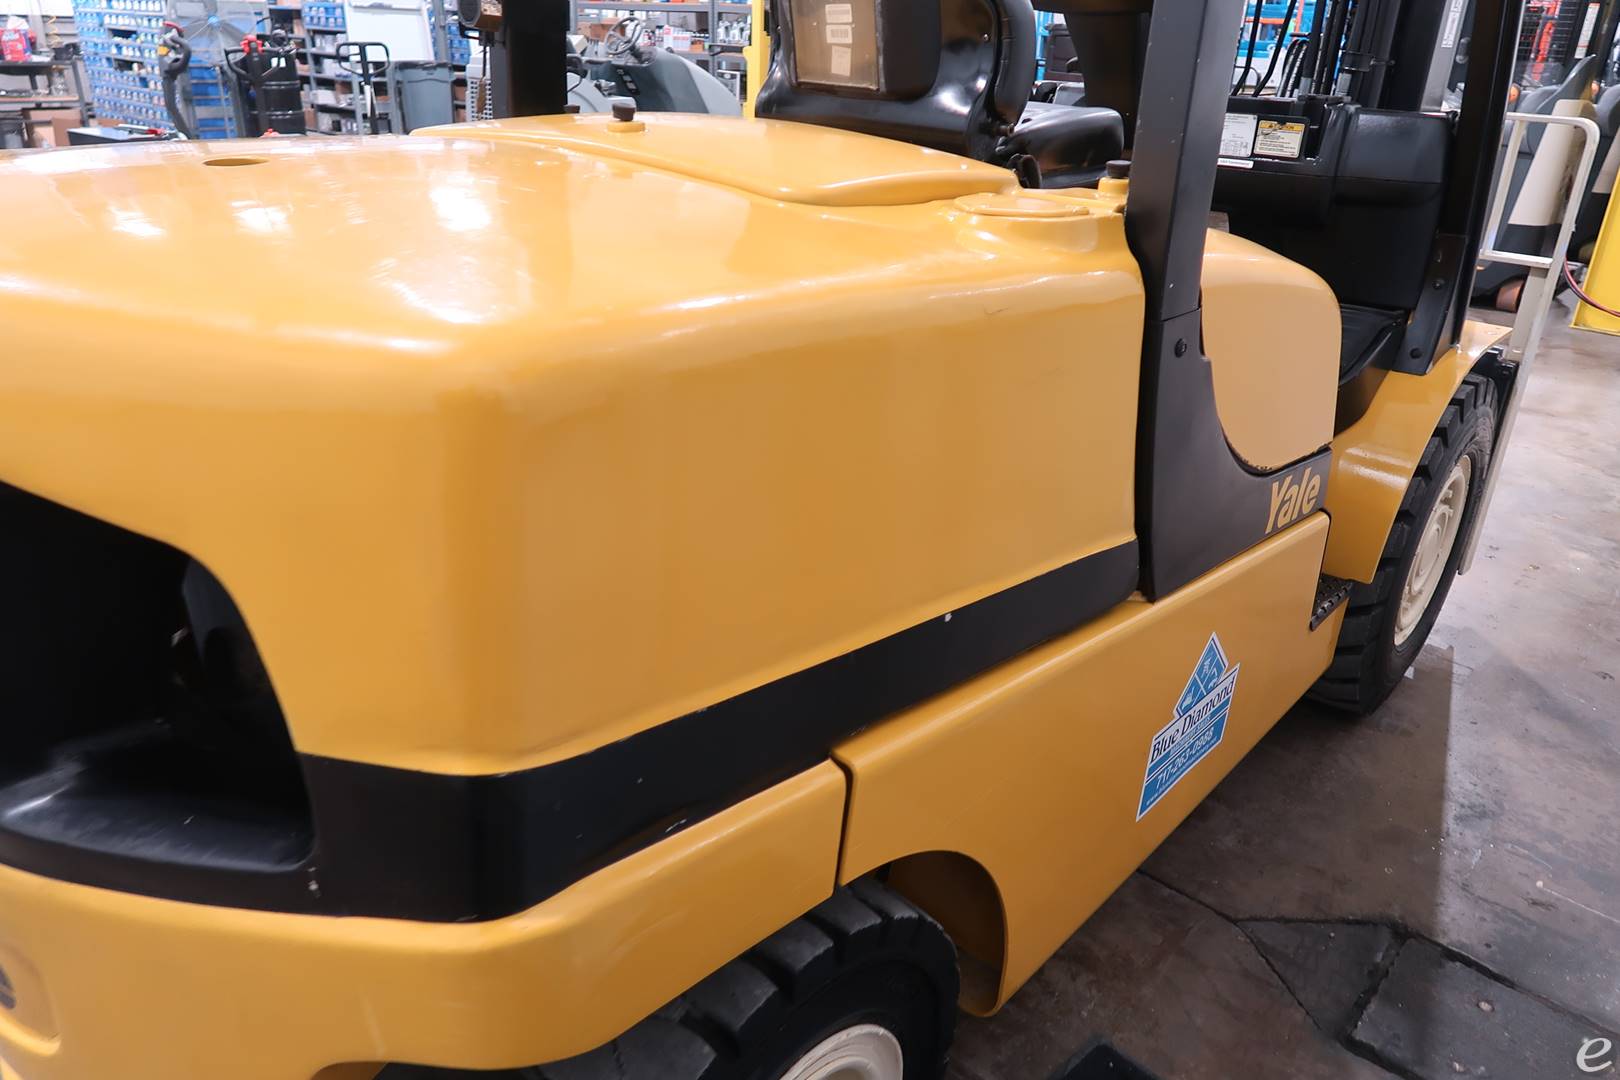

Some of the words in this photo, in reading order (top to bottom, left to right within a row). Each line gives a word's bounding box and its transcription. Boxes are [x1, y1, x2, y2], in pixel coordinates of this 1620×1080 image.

[1265, 467, 1320, 535] Yale
[1150, 728, 1180, 762] Blue
[1181, 675, 1236, 736] Diamond
